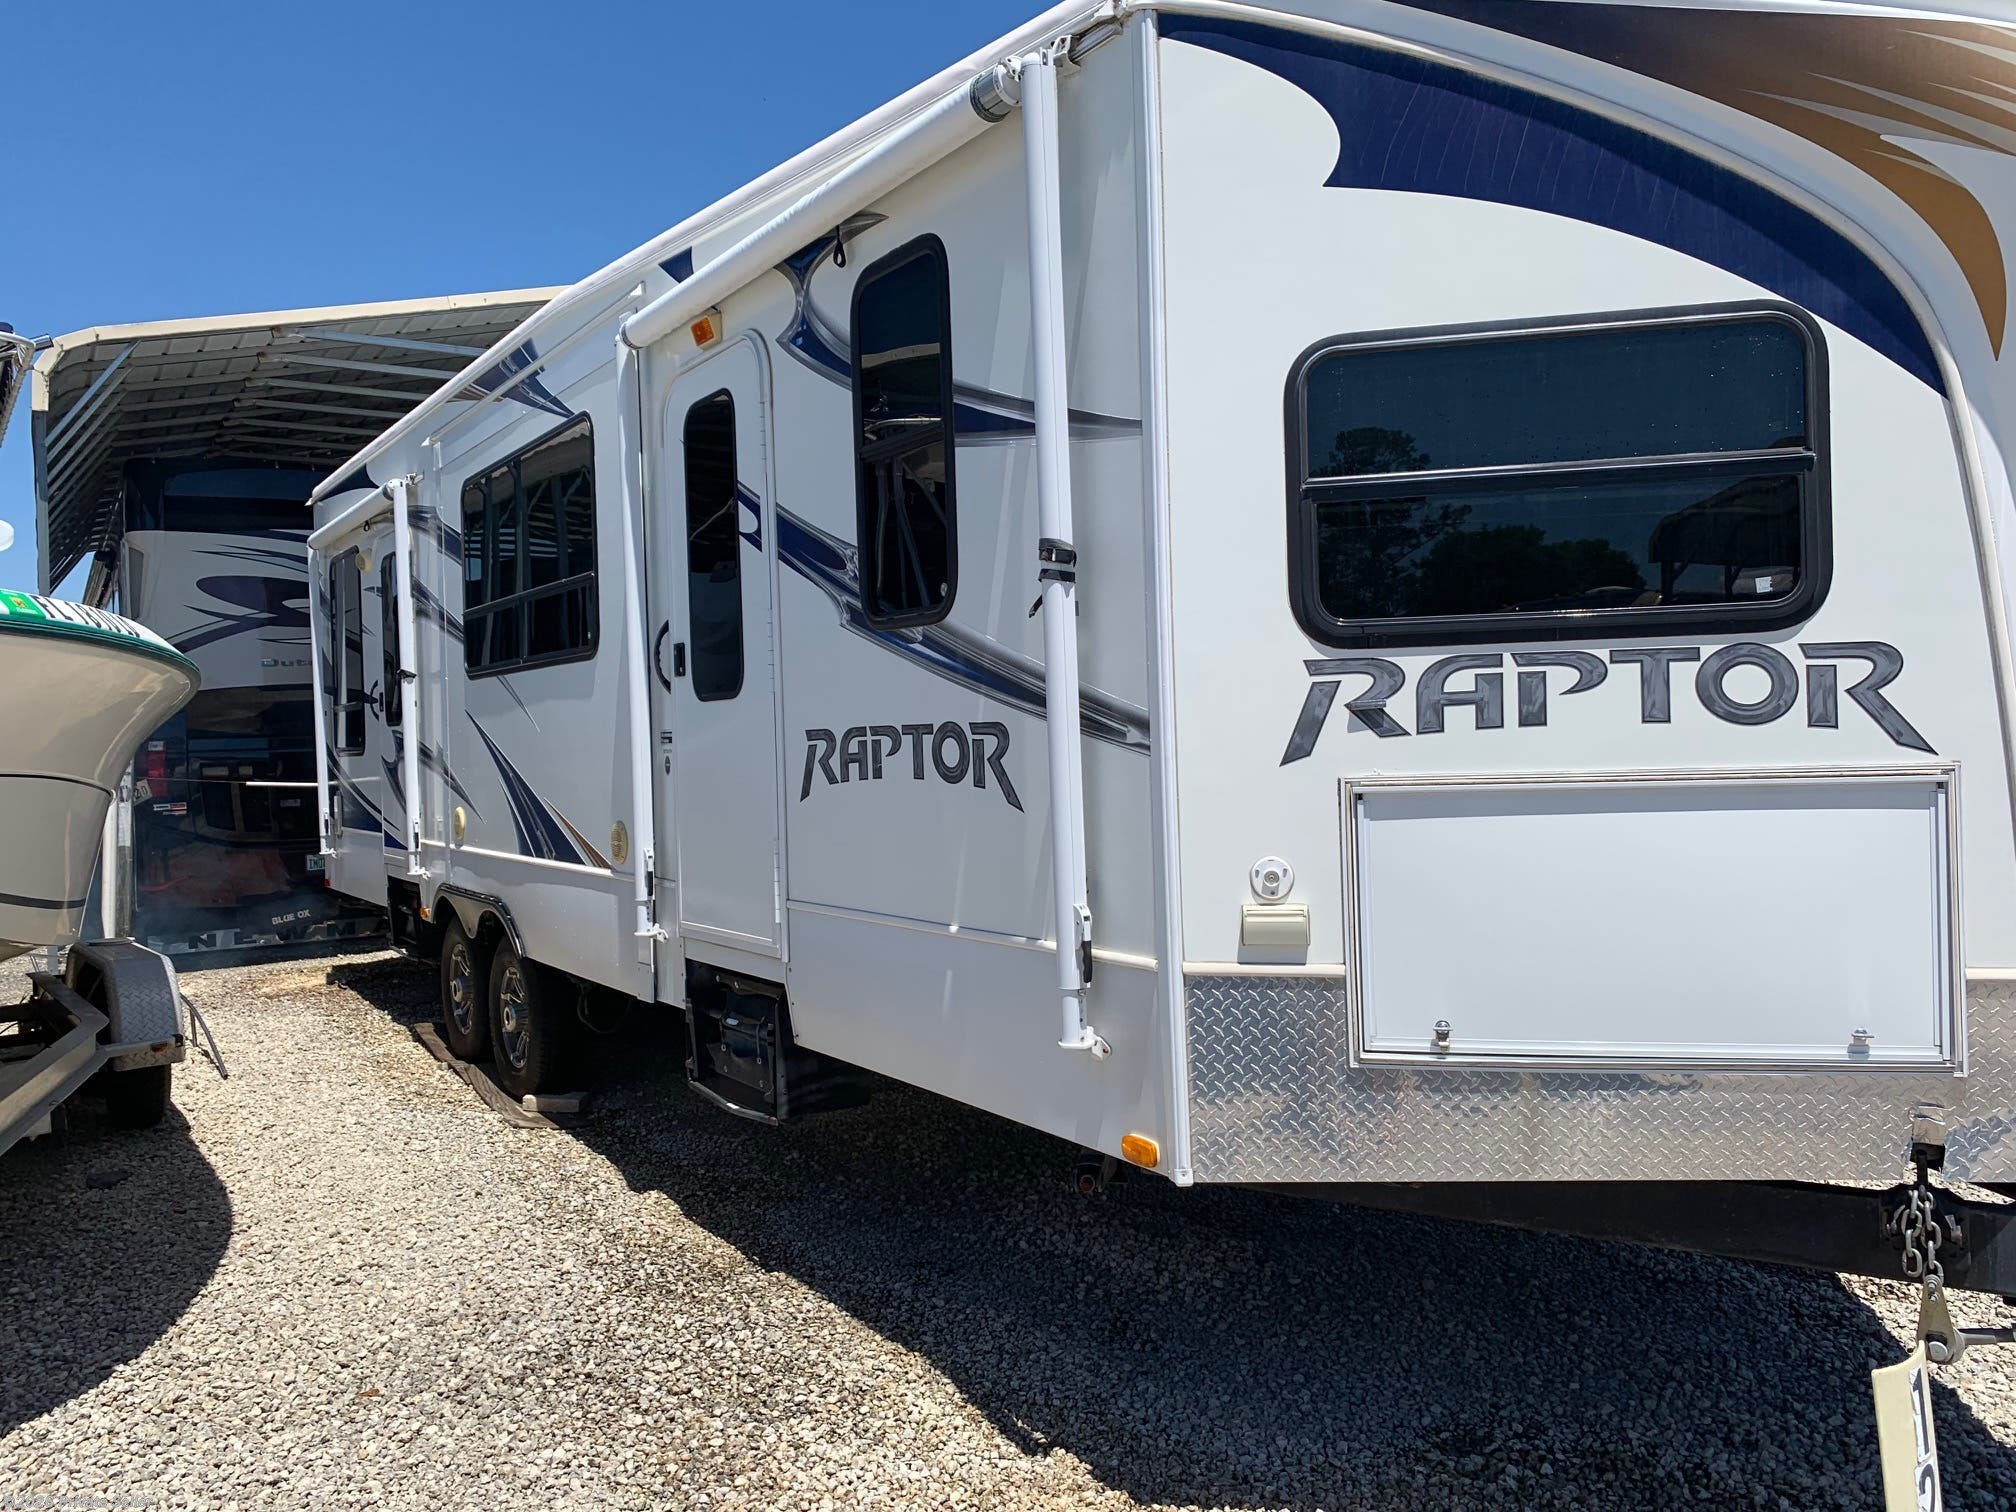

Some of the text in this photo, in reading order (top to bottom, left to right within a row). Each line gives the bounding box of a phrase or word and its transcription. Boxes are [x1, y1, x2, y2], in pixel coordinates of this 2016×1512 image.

[32, 594, 74, 621] FL
[1279, 641, 1939, 767] RAPTOR
[800, 721, 1025, 813] RAPTOR
[271, 909, 311, 925] BLUE OX
